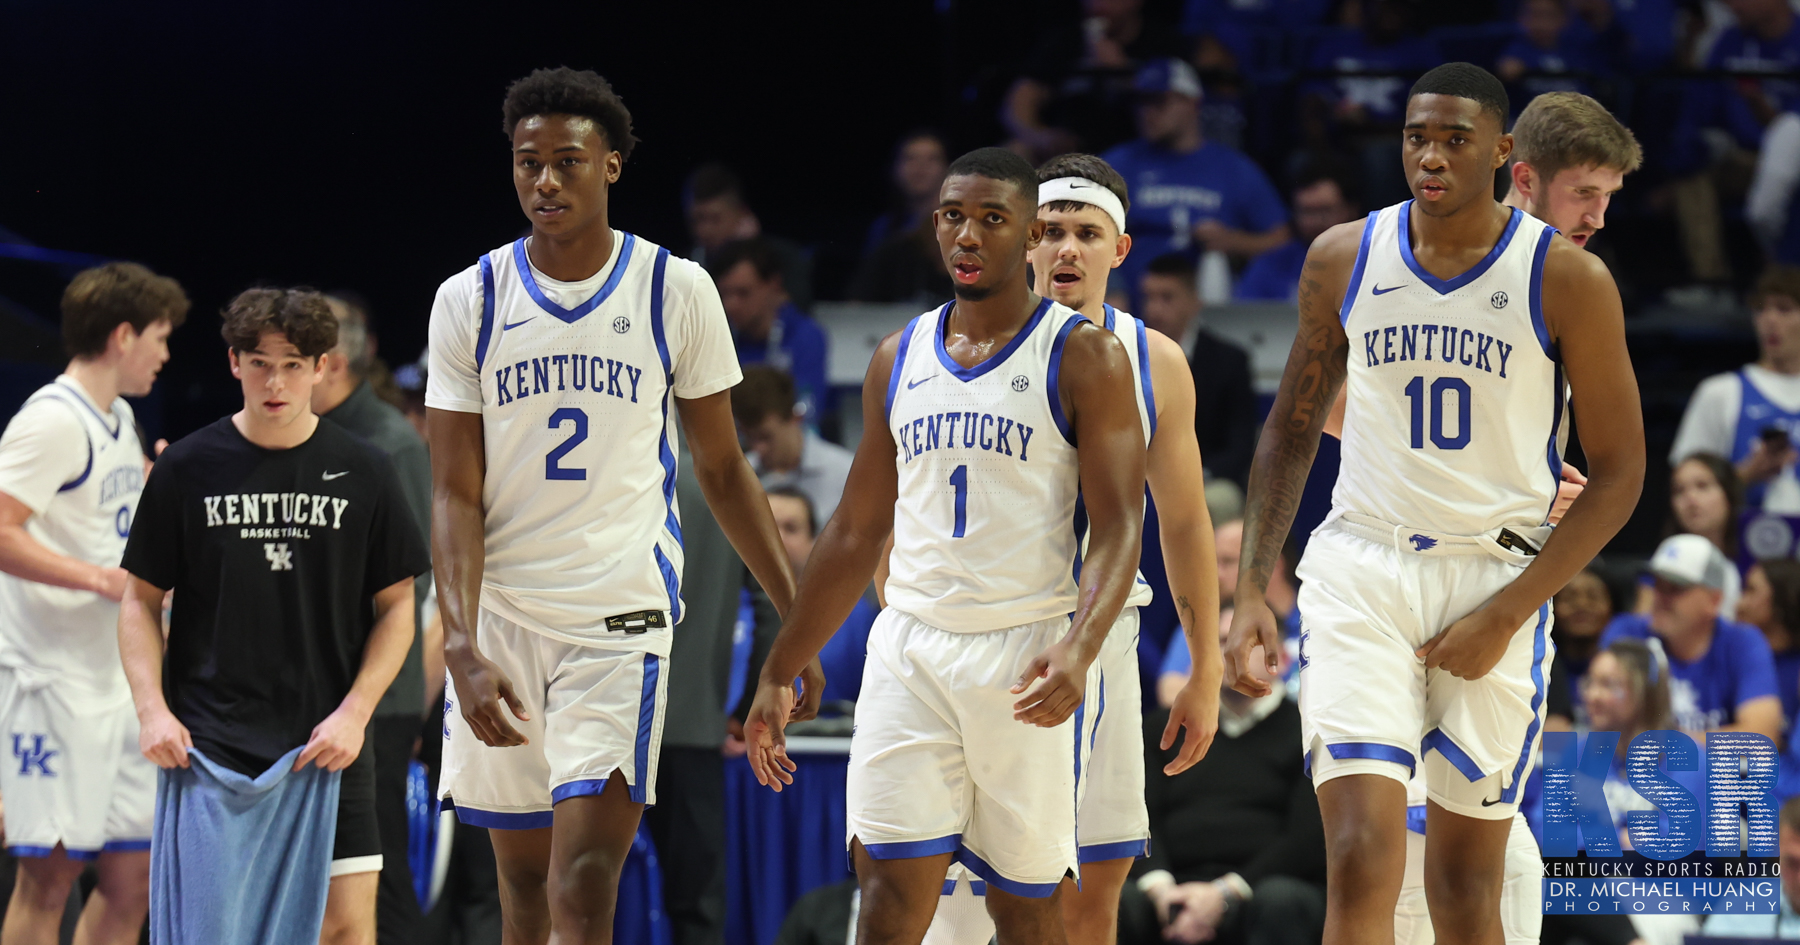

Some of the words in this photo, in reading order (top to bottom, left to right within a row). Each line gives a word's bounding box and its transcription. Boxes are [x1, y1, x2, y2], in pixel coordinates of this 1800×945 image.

[1491, 291, 1508, 309] SEC
[613, 316, 630, 333] SEC
[1364, 324, 1512, 379] KENTUCKY
[495, 354, 642, 407] KENTUCKY
[1012, 375, 1029, 392] SEC
[1405, 376, 1471, 450] 10
[545, 408, 589, 480] 2
[899, 412, 1033, 464] KENTUCKY
[204, 492, 349, 530] KENTUCKY
[949, 465, 968, 538] 1
[264, 543, 293, 571] UK
[647, 615, 658, 623] 46
[11, 732, 60, 777] UK
